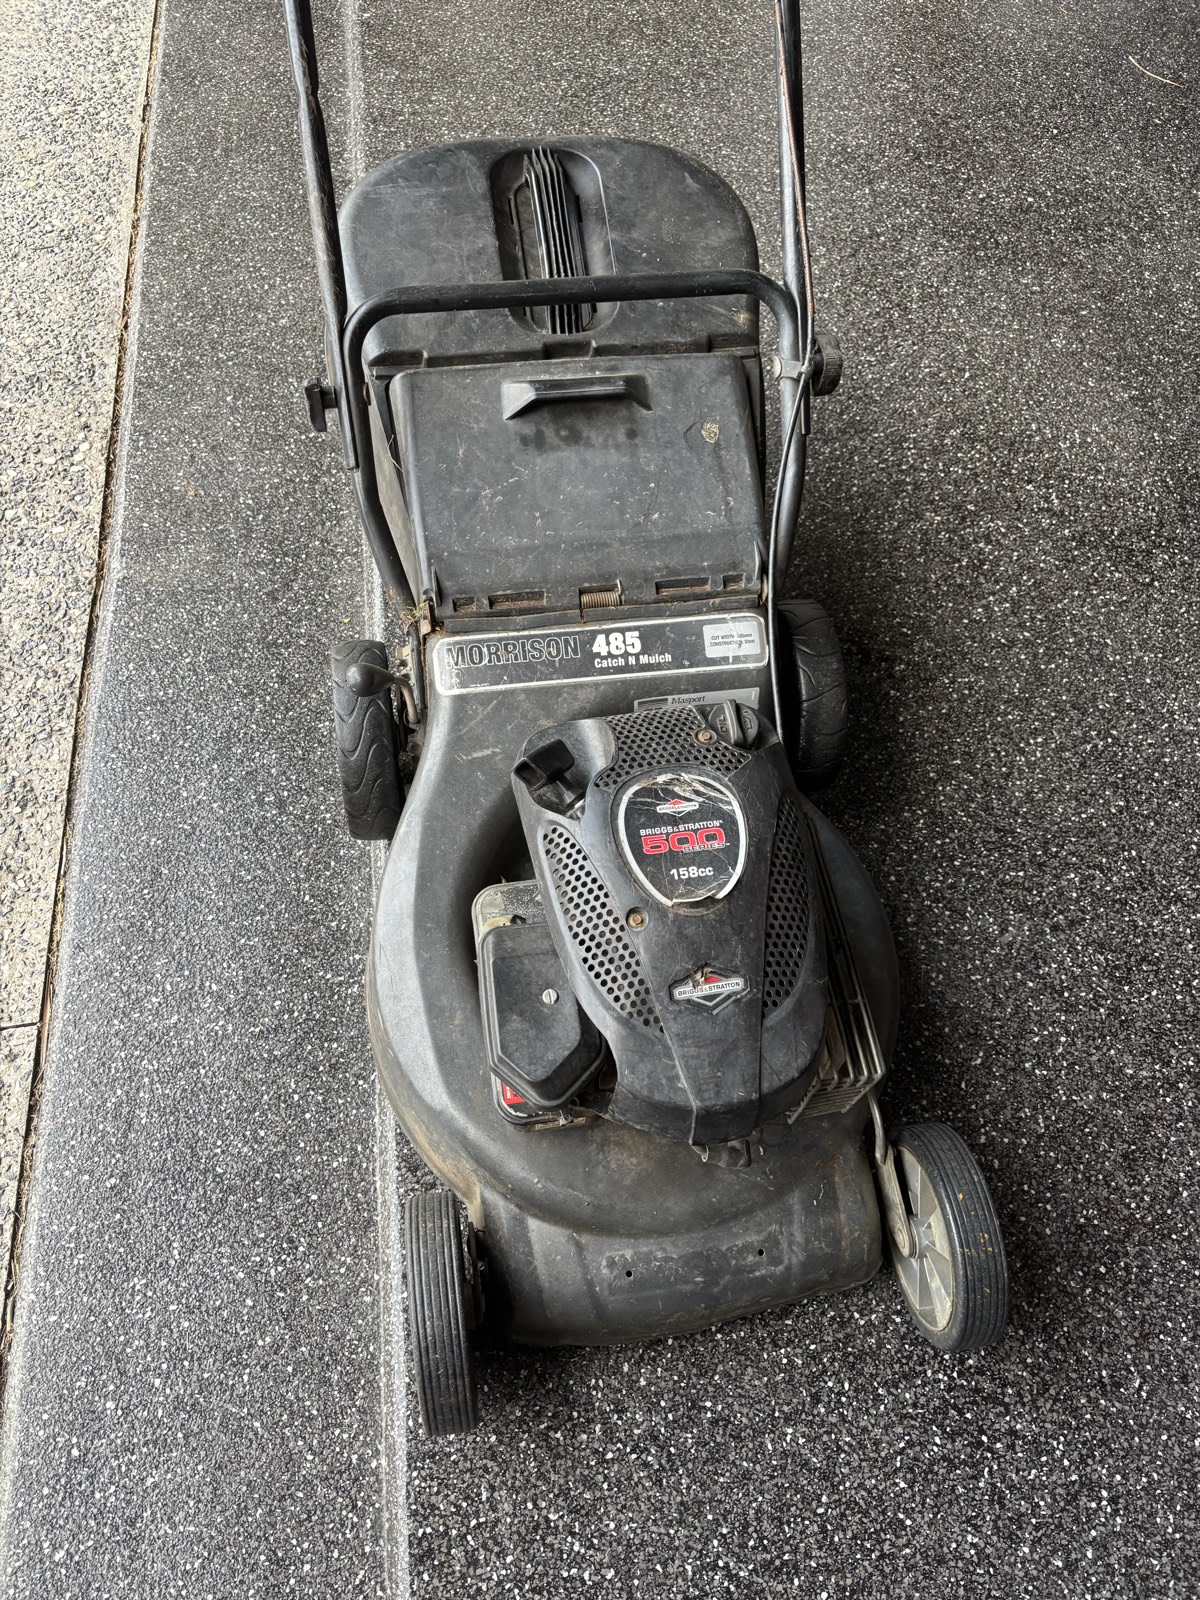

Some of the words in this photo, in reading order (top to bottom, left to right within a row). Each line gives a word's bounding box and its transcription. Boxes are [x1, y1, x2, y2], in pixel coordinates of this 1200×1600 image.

[445, 635, 581, 669] MORRISON
[592, 631, 642, 656] 485
[594, 657, 625, 668] Catch
[628, 656, 636, 665] N
[639, 653, 672, 665] Mulch
[671, 696, 706, 705] Masport
[642, 828, 725, 854] 500
[670, 866, 714, 880] 158cc
